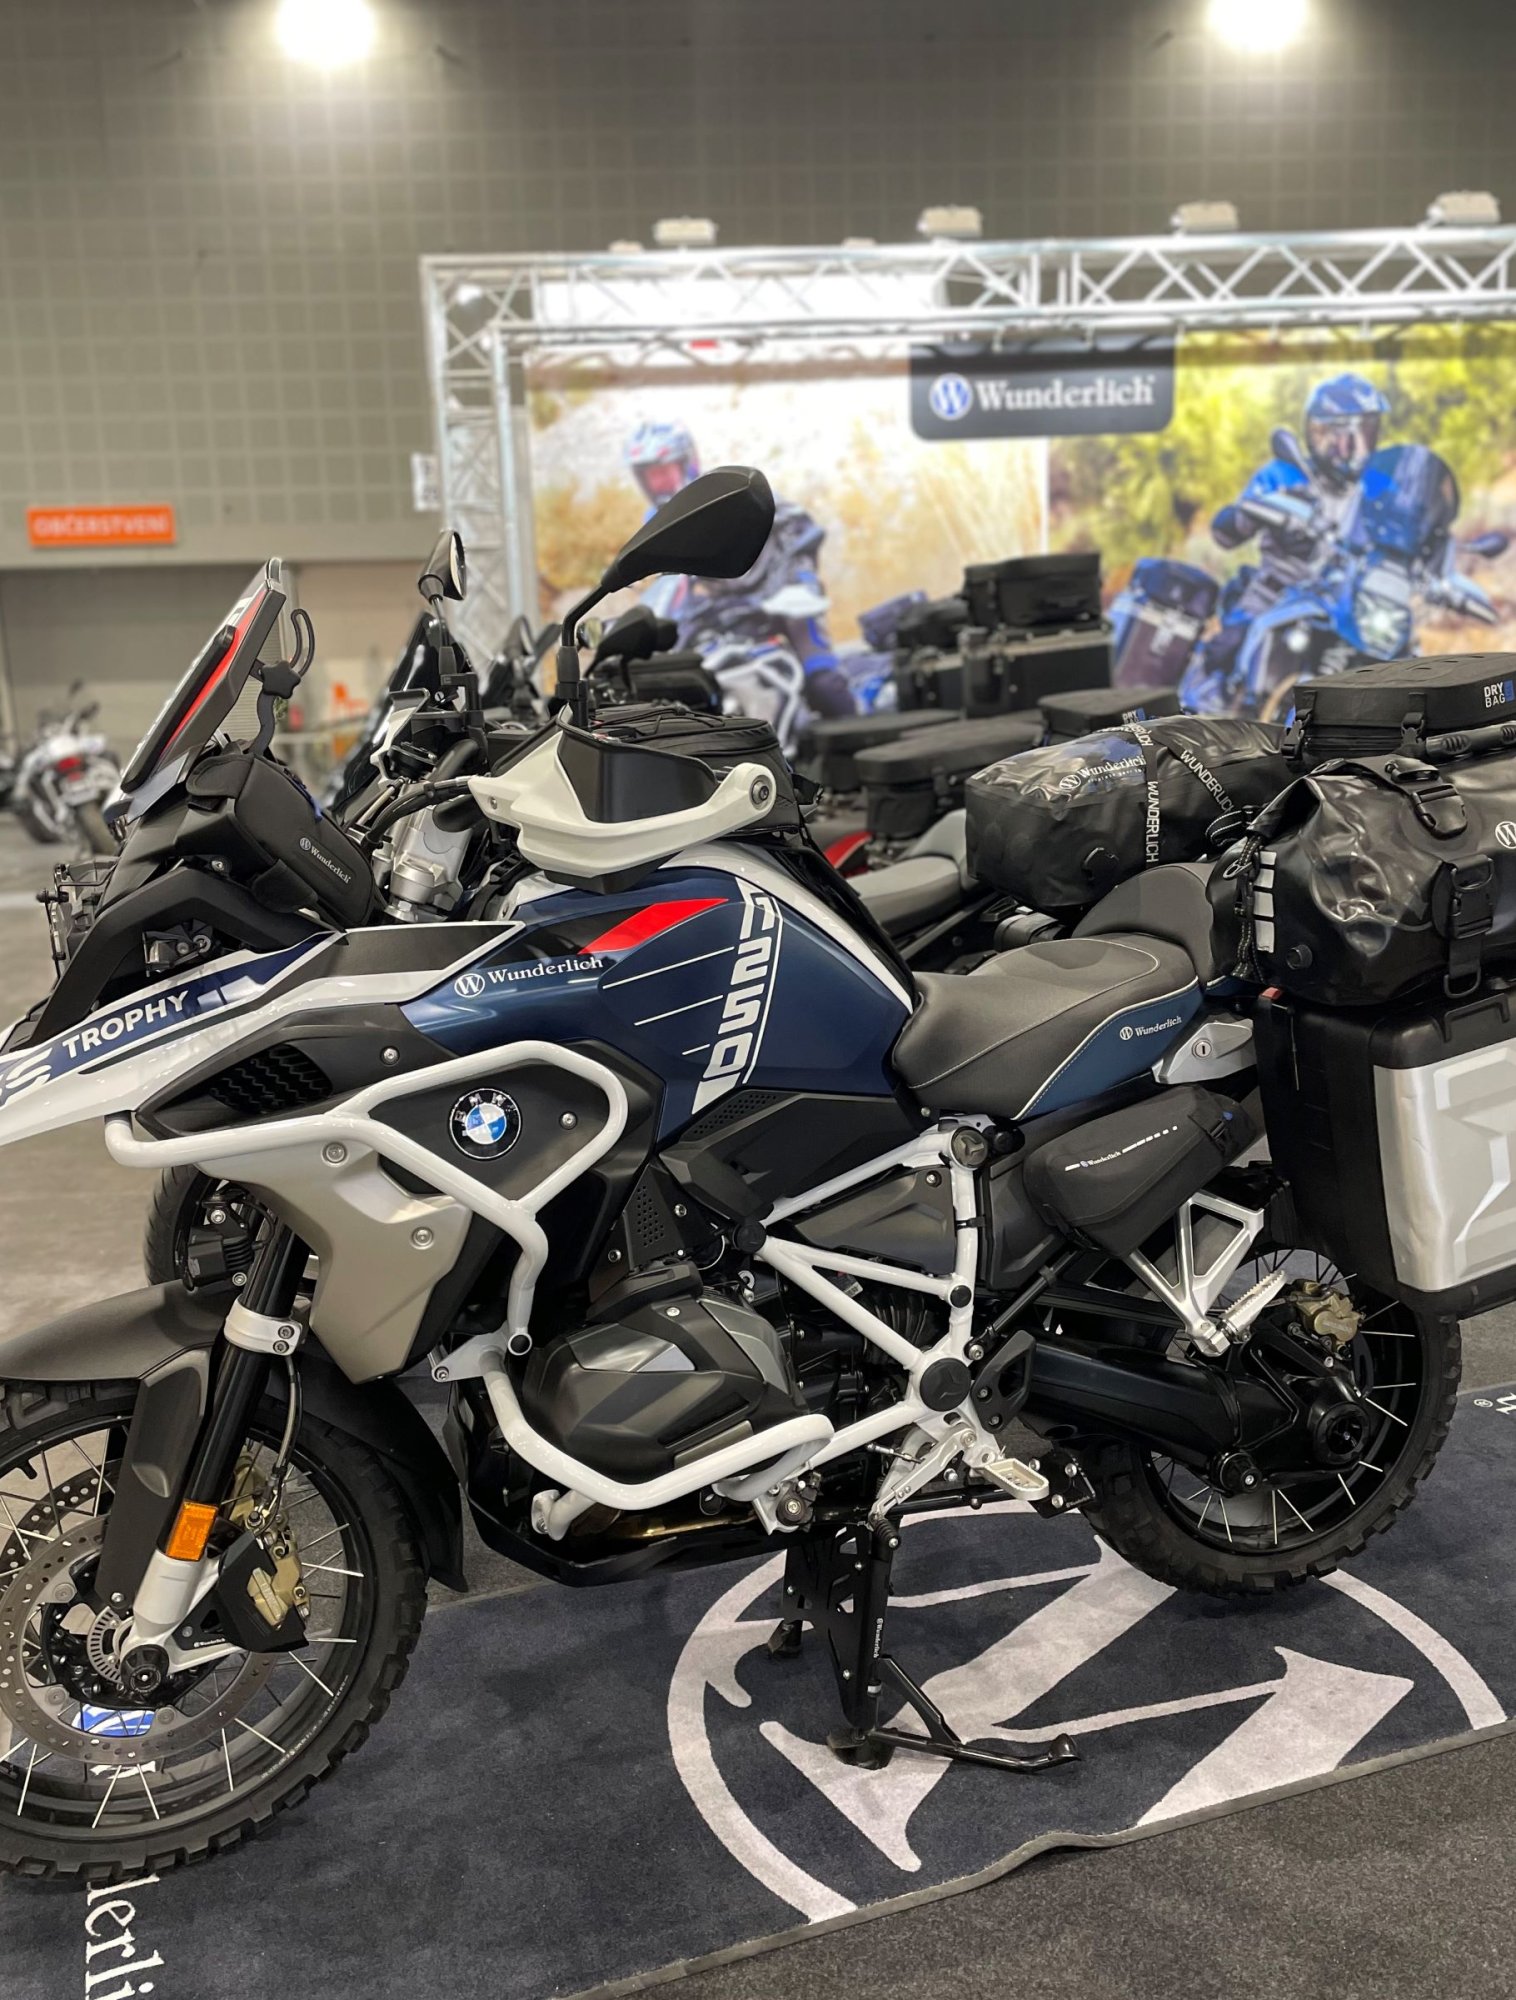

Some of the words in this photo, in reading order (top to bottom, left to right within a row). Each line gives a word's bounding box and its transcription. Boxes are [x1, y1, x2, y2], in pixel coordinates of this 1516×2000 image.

[975, 374, 1156, 411] Wunderlich
[1484, 682, 1503, 698] DRY
[1485, 693, 1506, 708] BAG
[1077, 755, 1147, 778] Wunderlich
[1146, 781, 1160, 862] WUNDERLICH
[311, 845, 352, 884] Wunderlich
[488, 956, 604, 984] Wunderlich
[702, 896, 775, 1079] 1250
[62, 990, 189, 1059] TROPHY
[1134, 1015, 1182, 1037] Wunderlich
[454, 1092, 507, 1123] BMW
